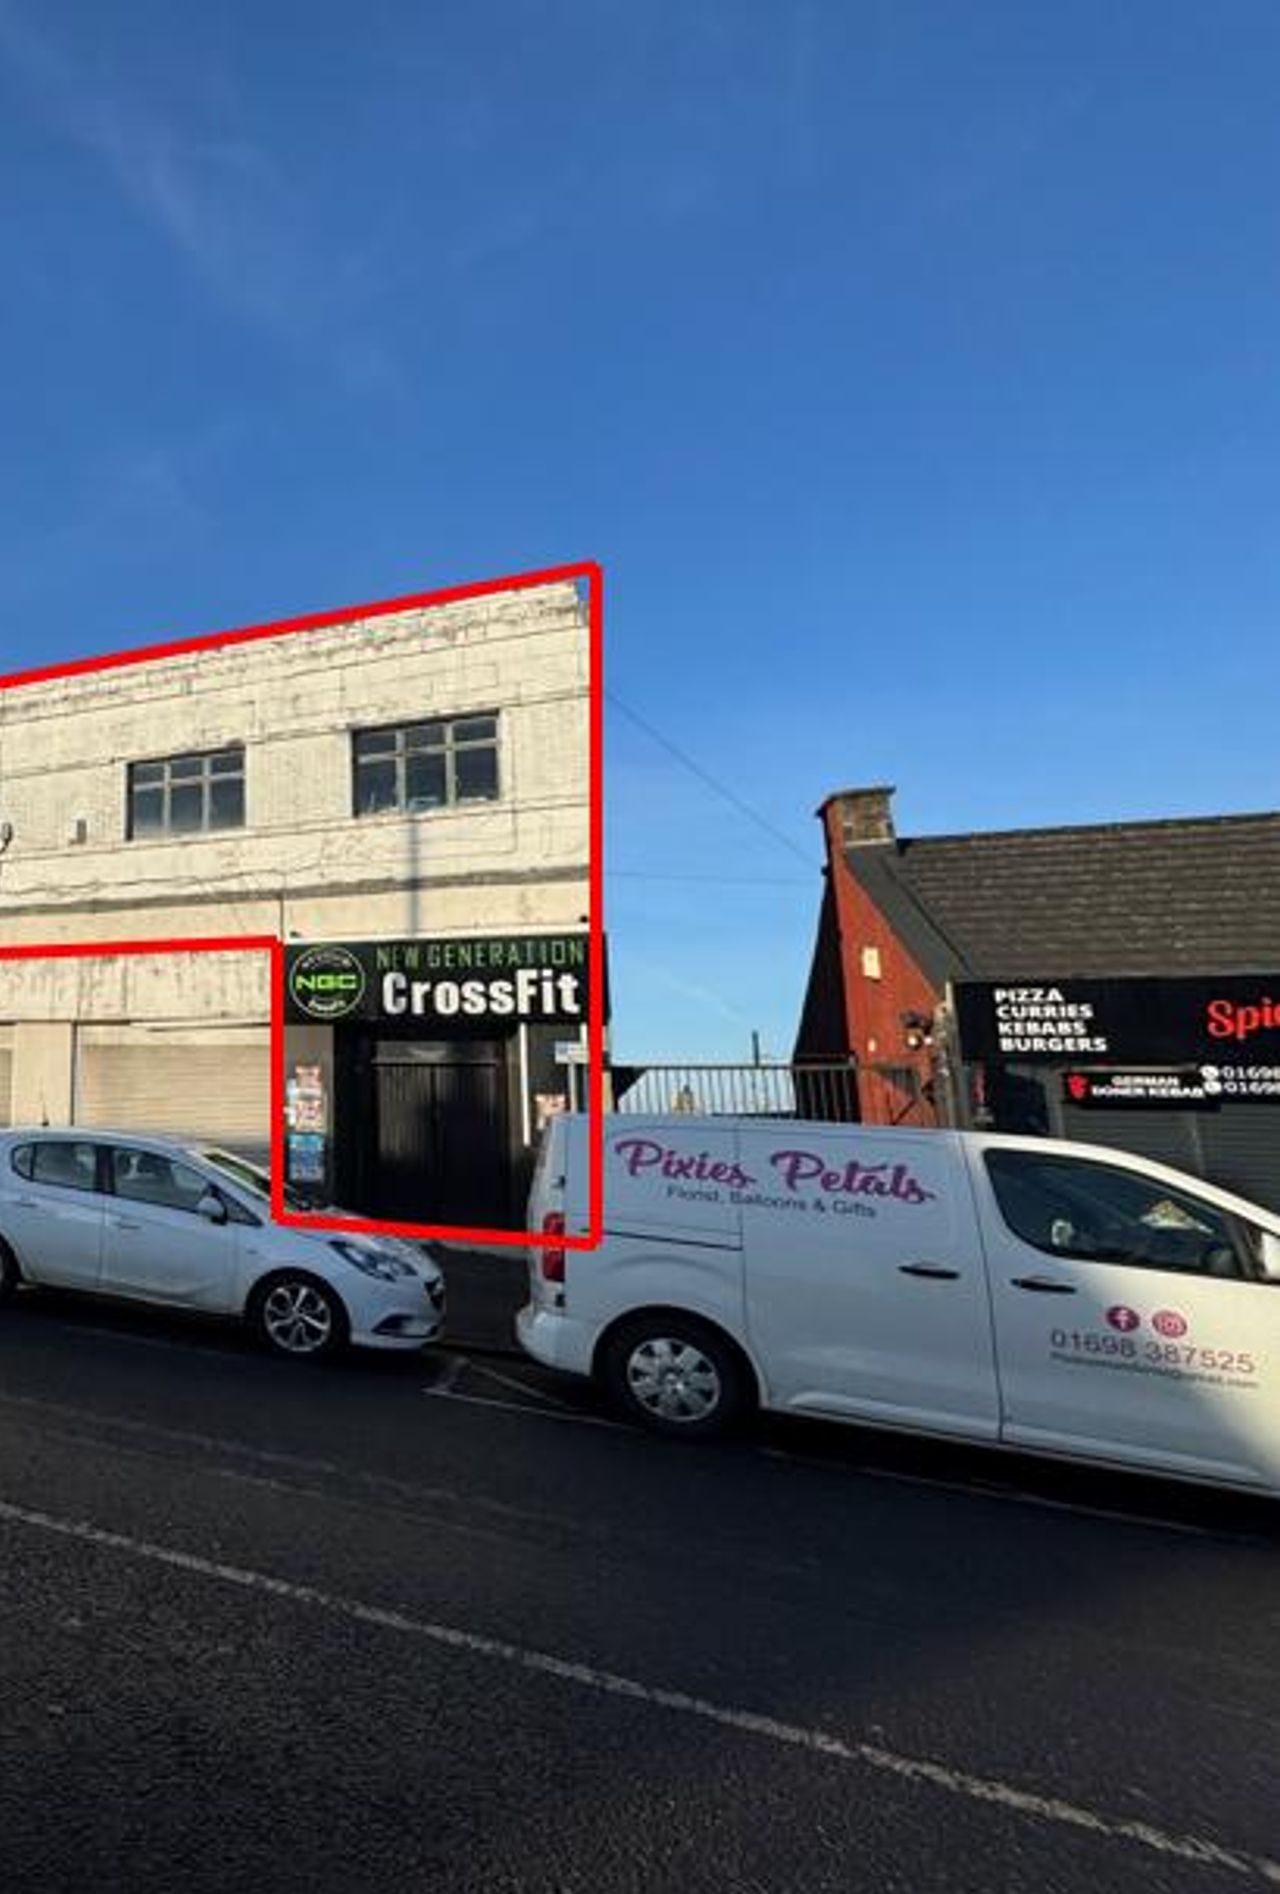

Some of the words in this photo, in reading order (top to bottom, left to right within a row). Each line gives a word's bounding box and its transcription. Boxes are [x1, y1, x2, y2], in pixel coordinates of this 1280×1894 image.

[375, 947, 419, 970] NEW
[428, 940, 584, 968] GENERATION
[382, 968, 581, 1015] CrossFit
[995, 987, 1064, 1003] PIZZA
[996, 1003, 1094, 1020] CURRIES
[998, 1021, 1087, 1036] KEBABS
[1000, 1037, 1107, 1052] BURGERS
[614, 1138, 757, 1189] Pixies
[771, 1150, 937, 1204] Petals
[729, 1190, 807, 1212] Balloons
[813, 1199, 826, 1214] &
[832, 1198, 877, 1218] Gifts
[1050, 1329, 1138, 1358] 01698
[1145, 1341, 1256, 1374] 387525
